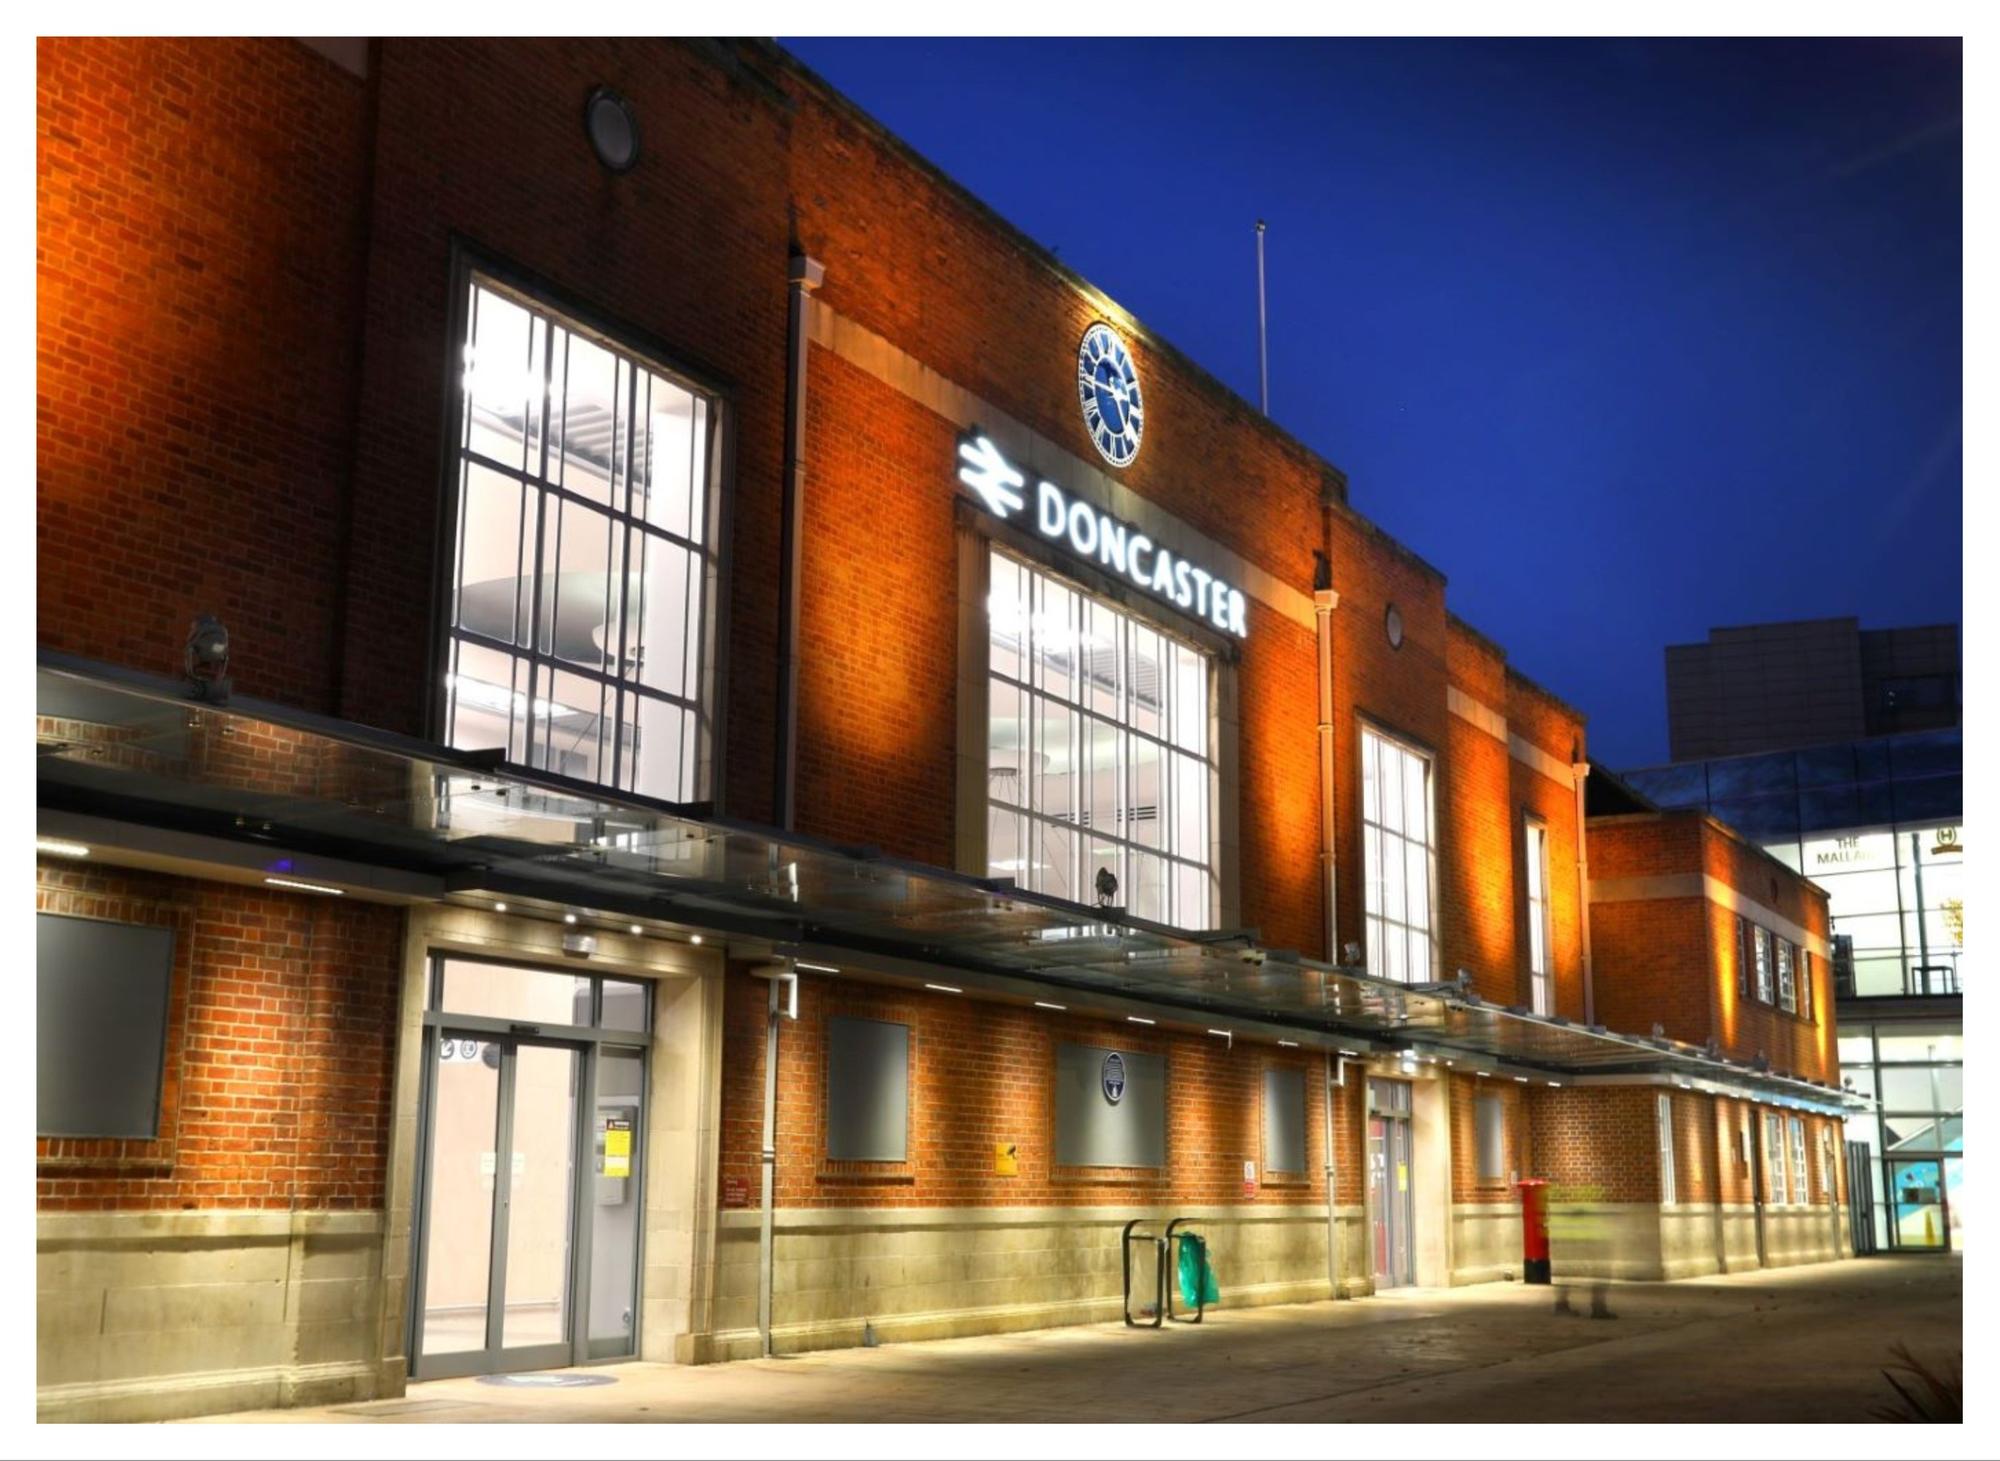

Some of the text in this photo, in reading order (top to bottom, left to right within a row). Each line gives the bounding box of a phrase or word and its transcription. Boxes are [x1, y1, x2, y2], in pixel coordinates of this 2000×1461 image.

[1038, 481, 1247, 639] DONCASTER
[1835, 837, 1860, 849] THE
[1817, 850, 1877, 864] MALLA
